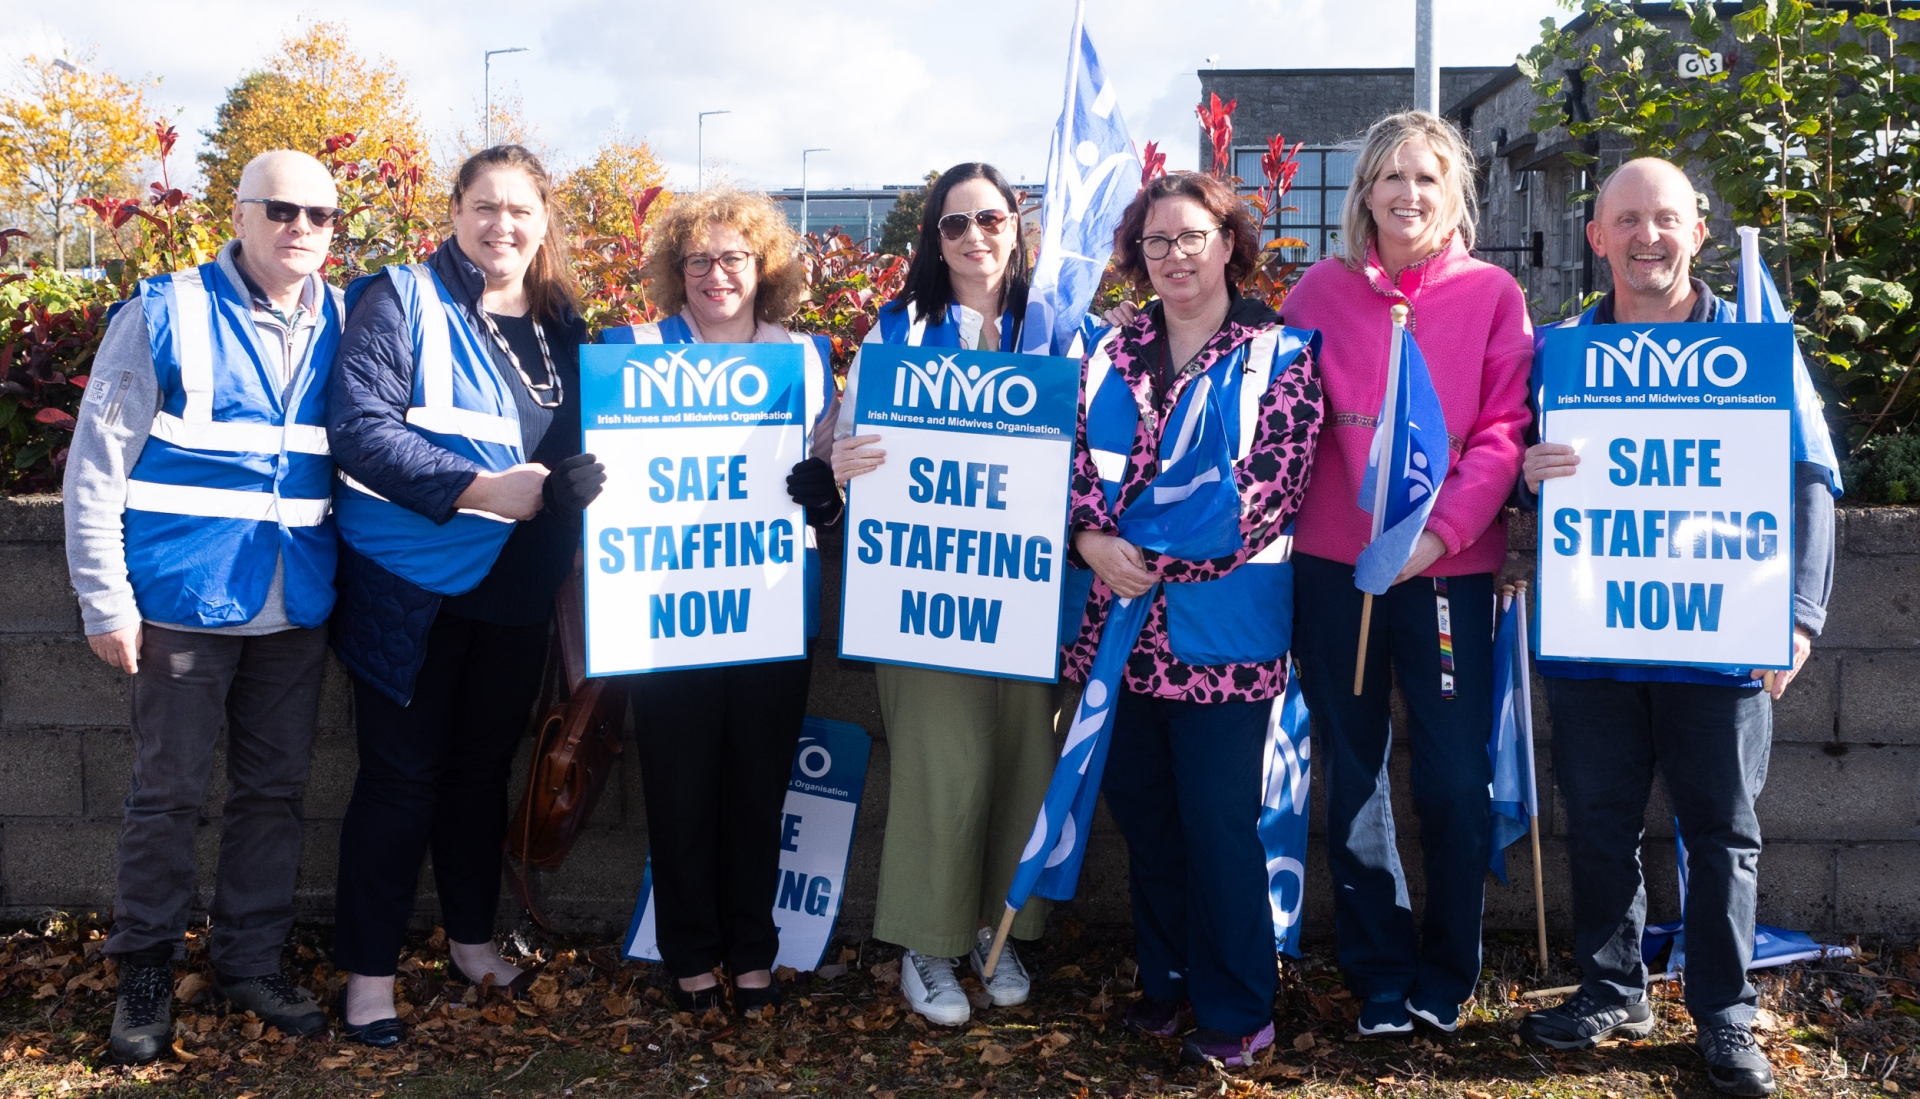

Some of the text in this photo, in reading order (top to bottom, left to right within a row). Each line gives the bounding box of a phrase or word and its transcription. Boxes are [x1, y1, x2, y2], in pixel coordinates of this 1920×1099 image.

[624, 348, 768, 408] INMO
[1586, 328, 1747, 388] INMO
[893, 353, 1037, 416] INMO
[1558, 393, 1777, 405] Irish Nurses and Midwives Organisation
[597, 410, 793, 424] Irish Nurses and Midwives Organisation
[867, 410, 1060, 435] Irish Nurses and Midwives Organisation
[648, 455, 748, 503] SAFE
[908, 456, 1007, 510] SAFE
[1608, 437, 1722, 488] SAFE
[599, 518, 794, 574] STAFFING
[857, 518, 1052, 583] STAFFING
[649, 588, 751, 639] NOW
[899, 590, 1003, 644] NOW
[1605, 580, 1724, 632] NOW
[795, 779, 848, 797] Organisation
